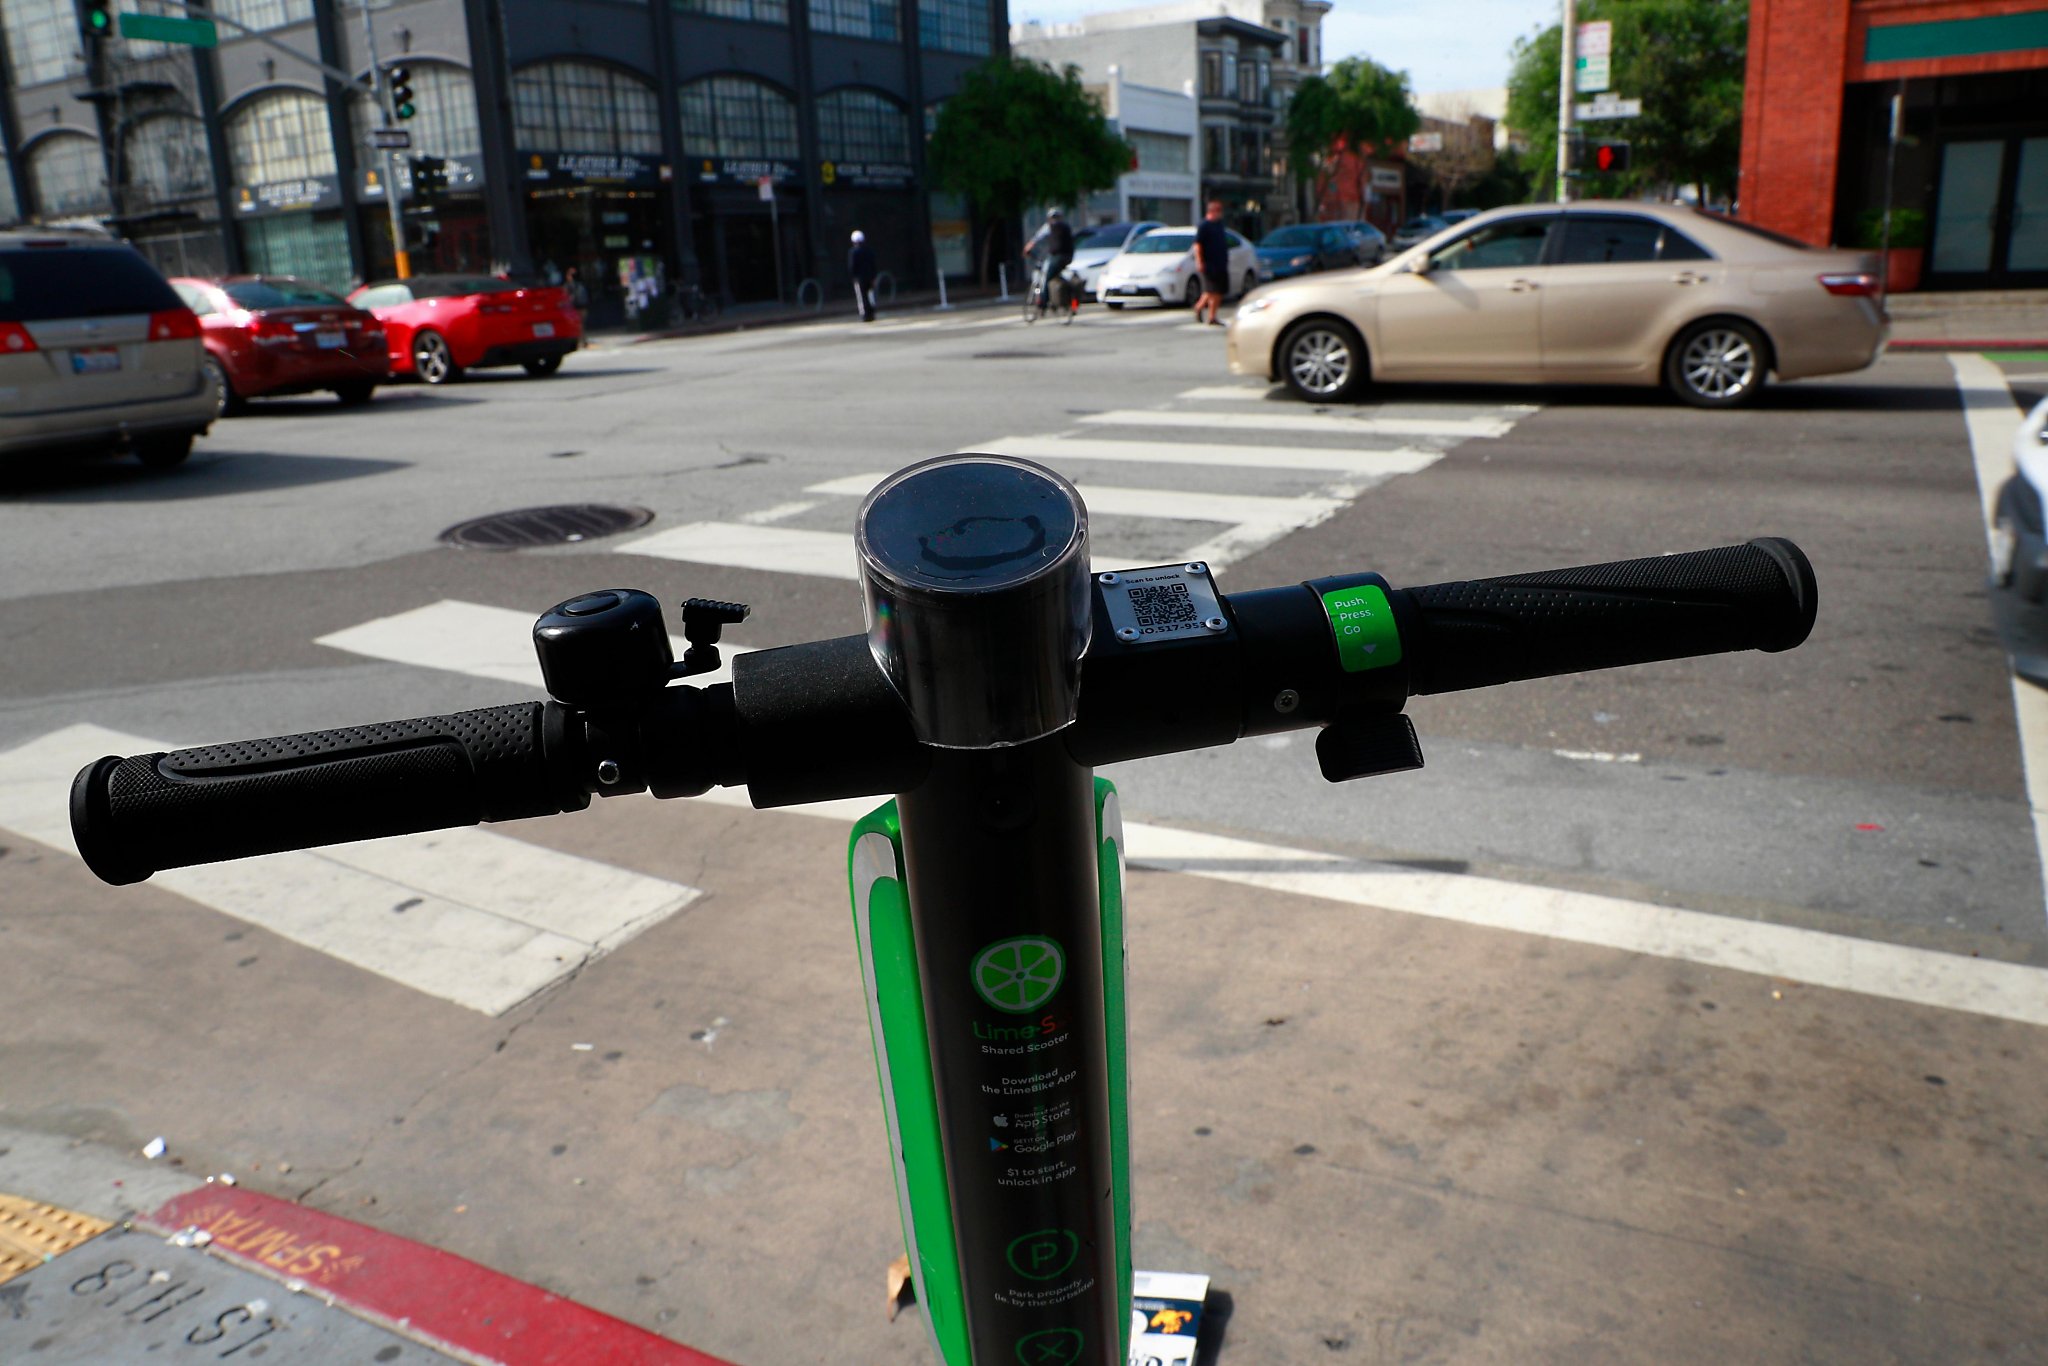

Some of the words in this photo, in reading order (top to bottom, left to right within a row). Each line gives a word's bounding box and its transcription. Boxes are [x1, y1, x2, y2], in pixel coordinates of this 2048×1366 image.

[1155, 573, 1180, 581] unlock
[1343, 625, 1361, 635] Go
[981, 1044, 1024, 1055] Shared
[1026, 1032, 1069, 1053] Scooter
[981, 1084, 1000, 1094] the
[1003, 1080, 1055, 1095] LimeBike
[1057, 1070, 1077, 1085] App
[1001, 1067, 1059, 1085] Download
[1015, 1119, 1040, 1129] App
[1041, 1107, 1071, 1124] Store
[1014, 1140, 1056, 1153] Google
[1056, 1130, 1077, 1145] Play
[997, 1178, 1039, 1187] unlock
[1042, 1175, 1053, 1184] in
[1055, 1165, 1077, 1180] app
[1007, 1167, 1019, 1177] $1
[1022, 1168, 1036, 1176] to
[1008, 1288, 1034, 1299] Park
[1036, 1279, 1082, 1299] properly
[1011, 1298, 1025, 1308] by
